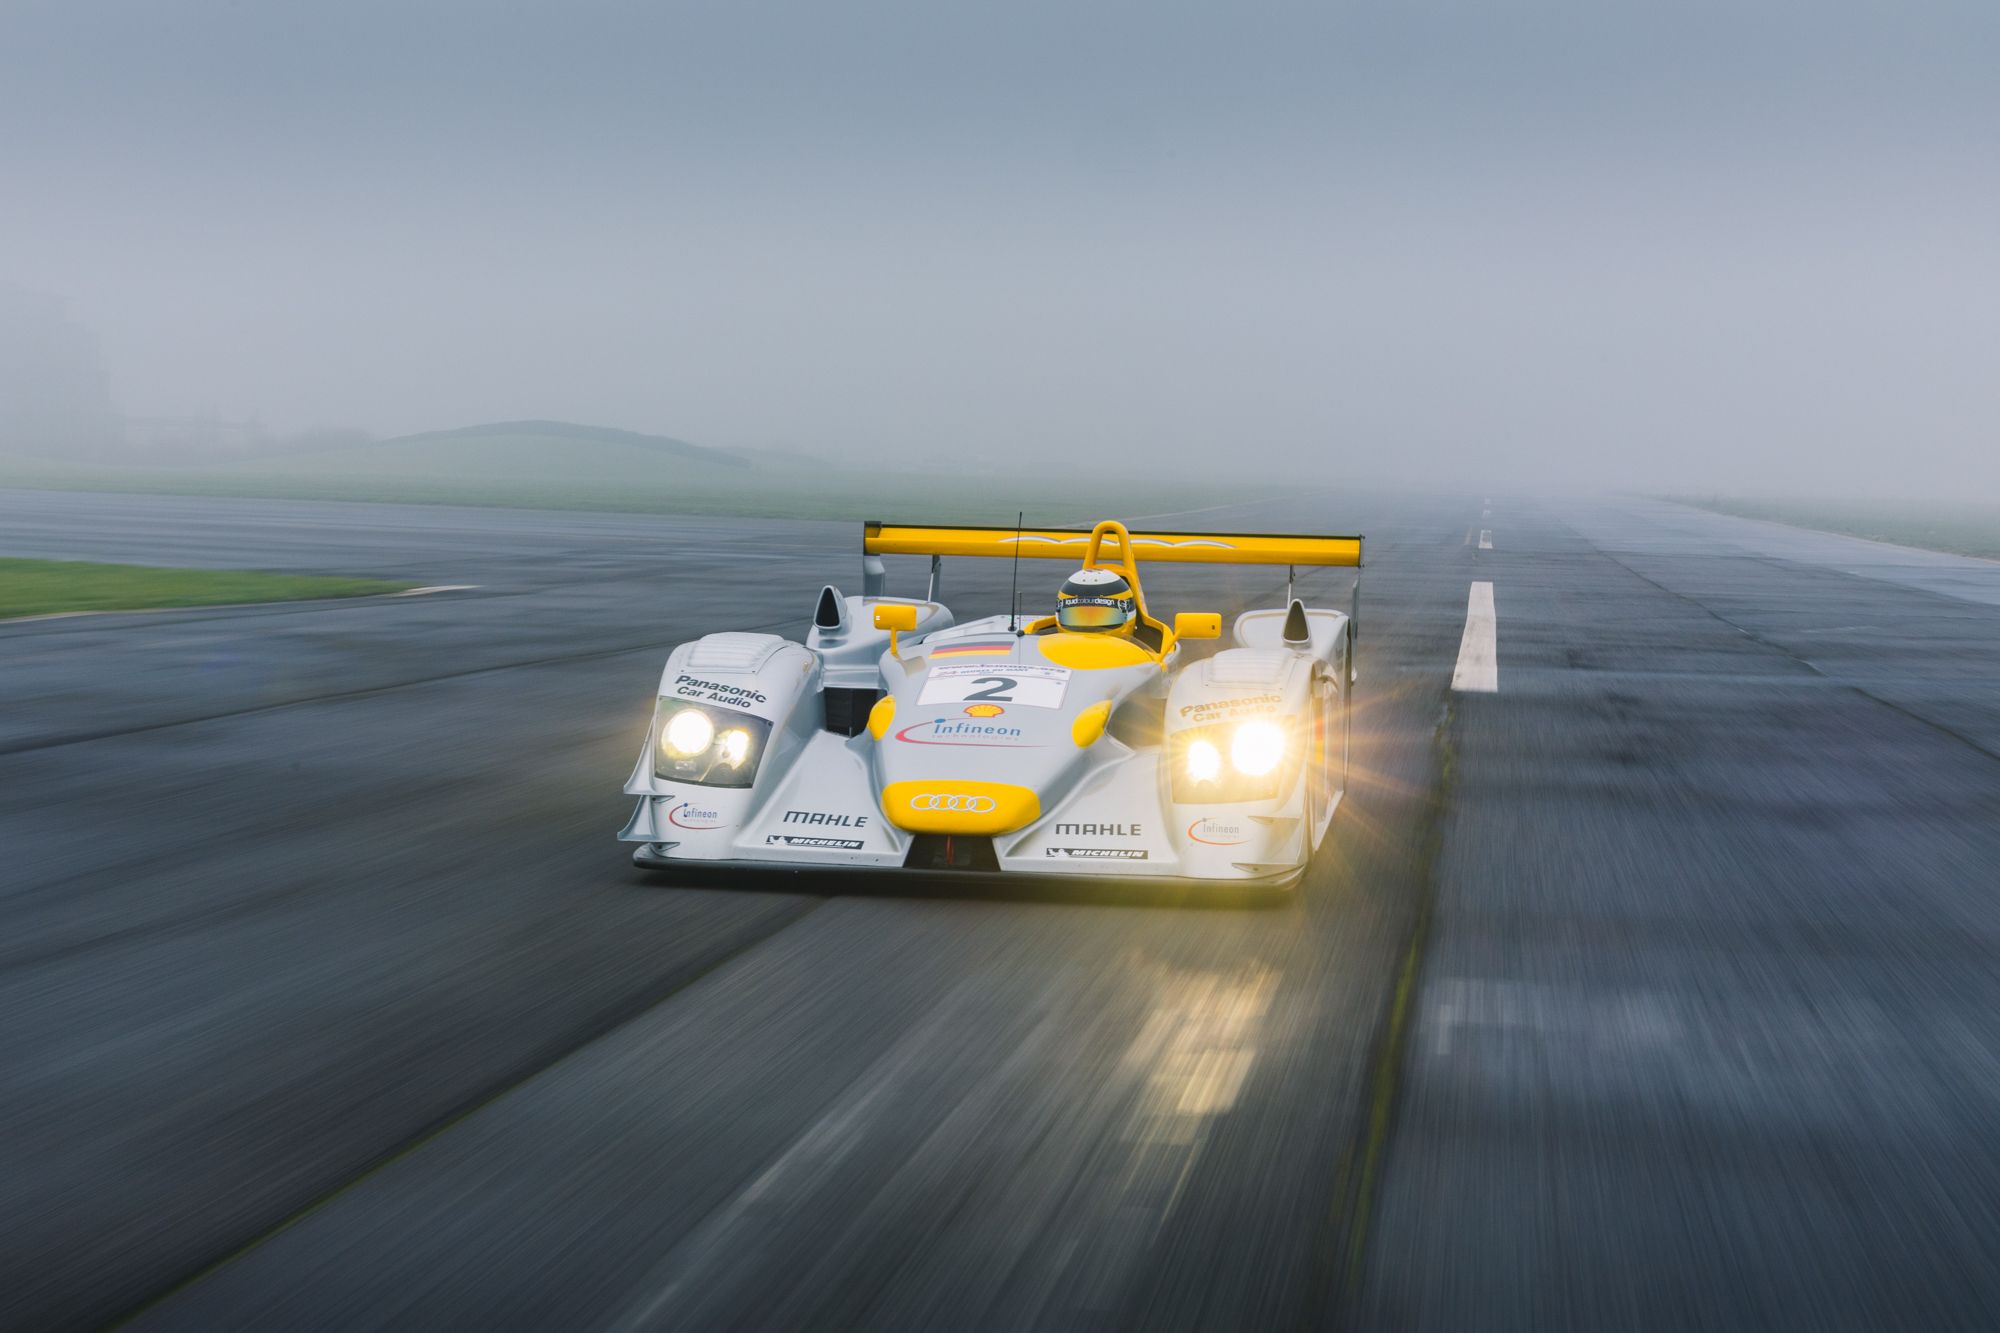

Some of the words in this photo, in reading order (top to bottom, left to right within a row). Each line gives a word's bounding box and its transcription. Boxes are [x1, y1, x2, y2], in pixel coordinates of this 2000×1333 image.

[675, 675, 767, 703] Panasonic
[677, 686, 704, 697] Car
[707, 692, 752, 708] Audio
[963, 677, 1018, 702] 2
[1180, 694, 1282, 717] Panasonic
[1192, 711, 1222, 722] Car
[783, 810, 869, 828] MAHLE
[1055, 823, 1142, 836] MAHLE
[789, 838, 861, 848] MICHELIN
[1071, 849, 1145, 857] MICHELIN
